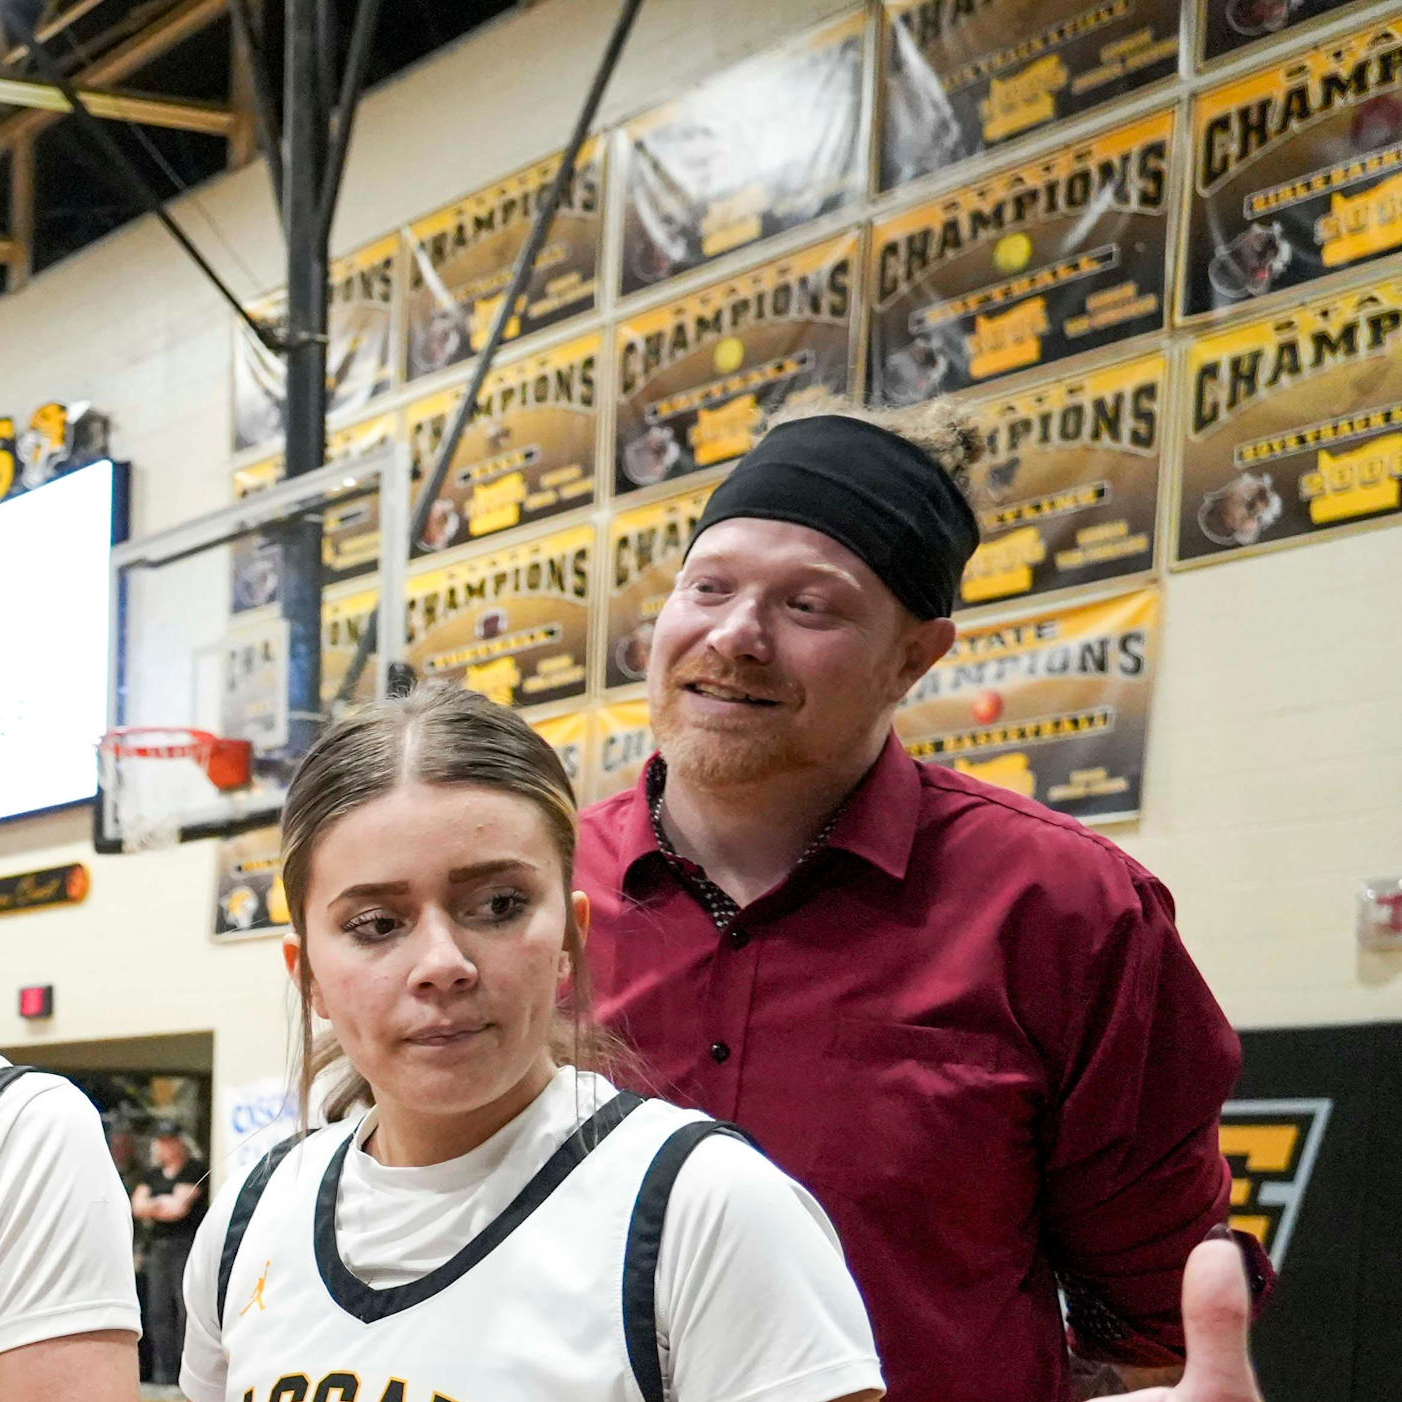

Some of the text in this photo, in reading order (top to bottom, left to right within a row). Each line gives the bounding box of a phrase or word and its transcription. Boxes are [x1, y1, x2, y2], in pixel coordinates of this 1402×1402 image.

[881, 141, 1166, 301] CHAMPIONS
[622, 259, 849, 395] CHAMPIONS
[411, 356, 595, 482] CHPIONS
[987, 383, 1157, 455] PIONS
[899, 632, 1145, 706] AMPIONS
[950, 622, 1057, 656] TATE
